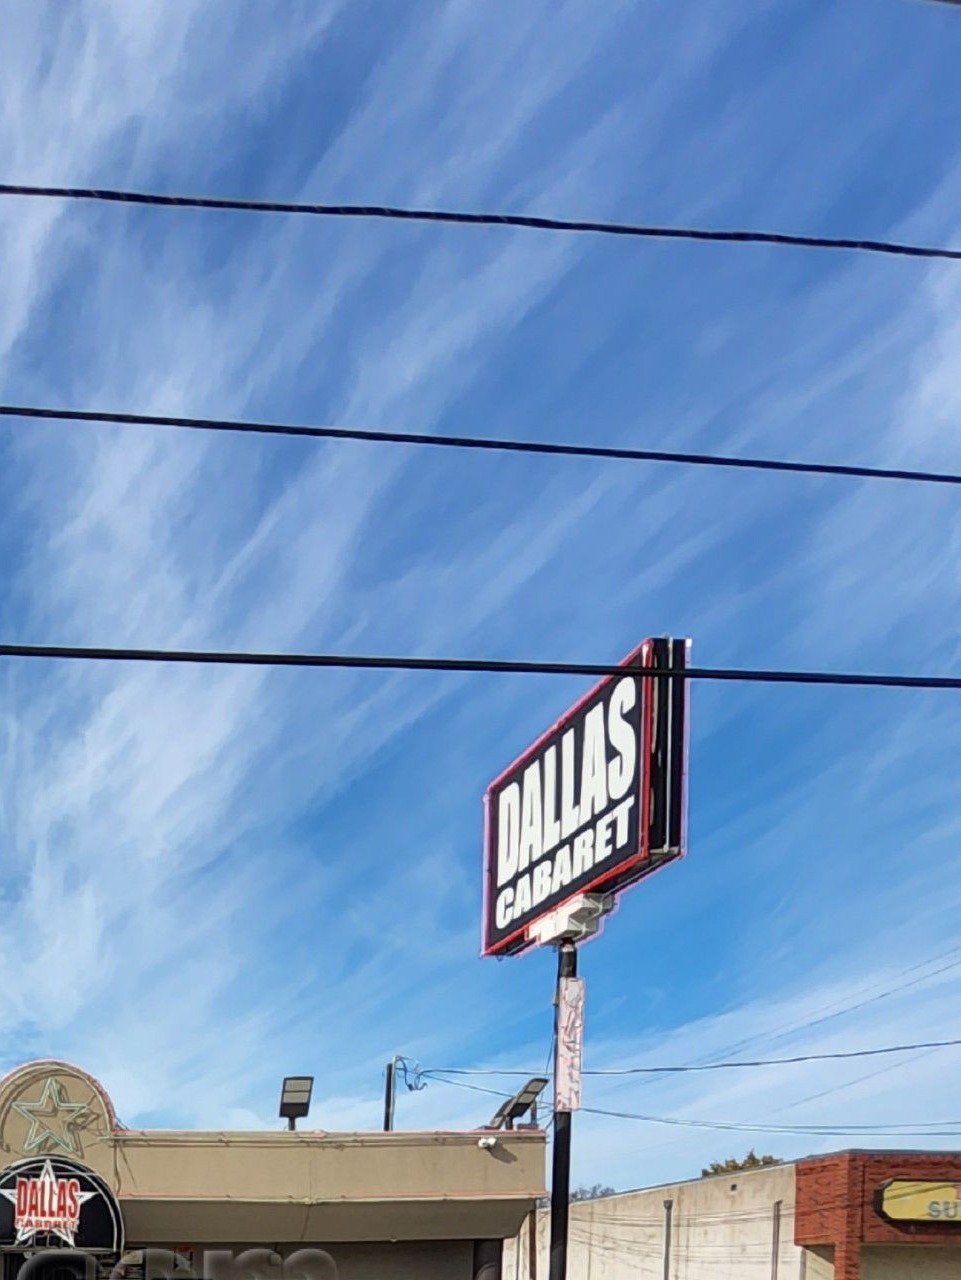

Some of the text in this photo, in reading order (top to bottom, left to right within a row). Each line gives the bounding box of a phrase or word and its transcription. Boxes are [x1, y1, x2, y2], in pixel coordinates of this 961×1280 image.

[496, 676, 636, 888] DALLAS
[495, 794, 635, 930] CABARET
[16, 1179, 80, 1219] DALLAS
